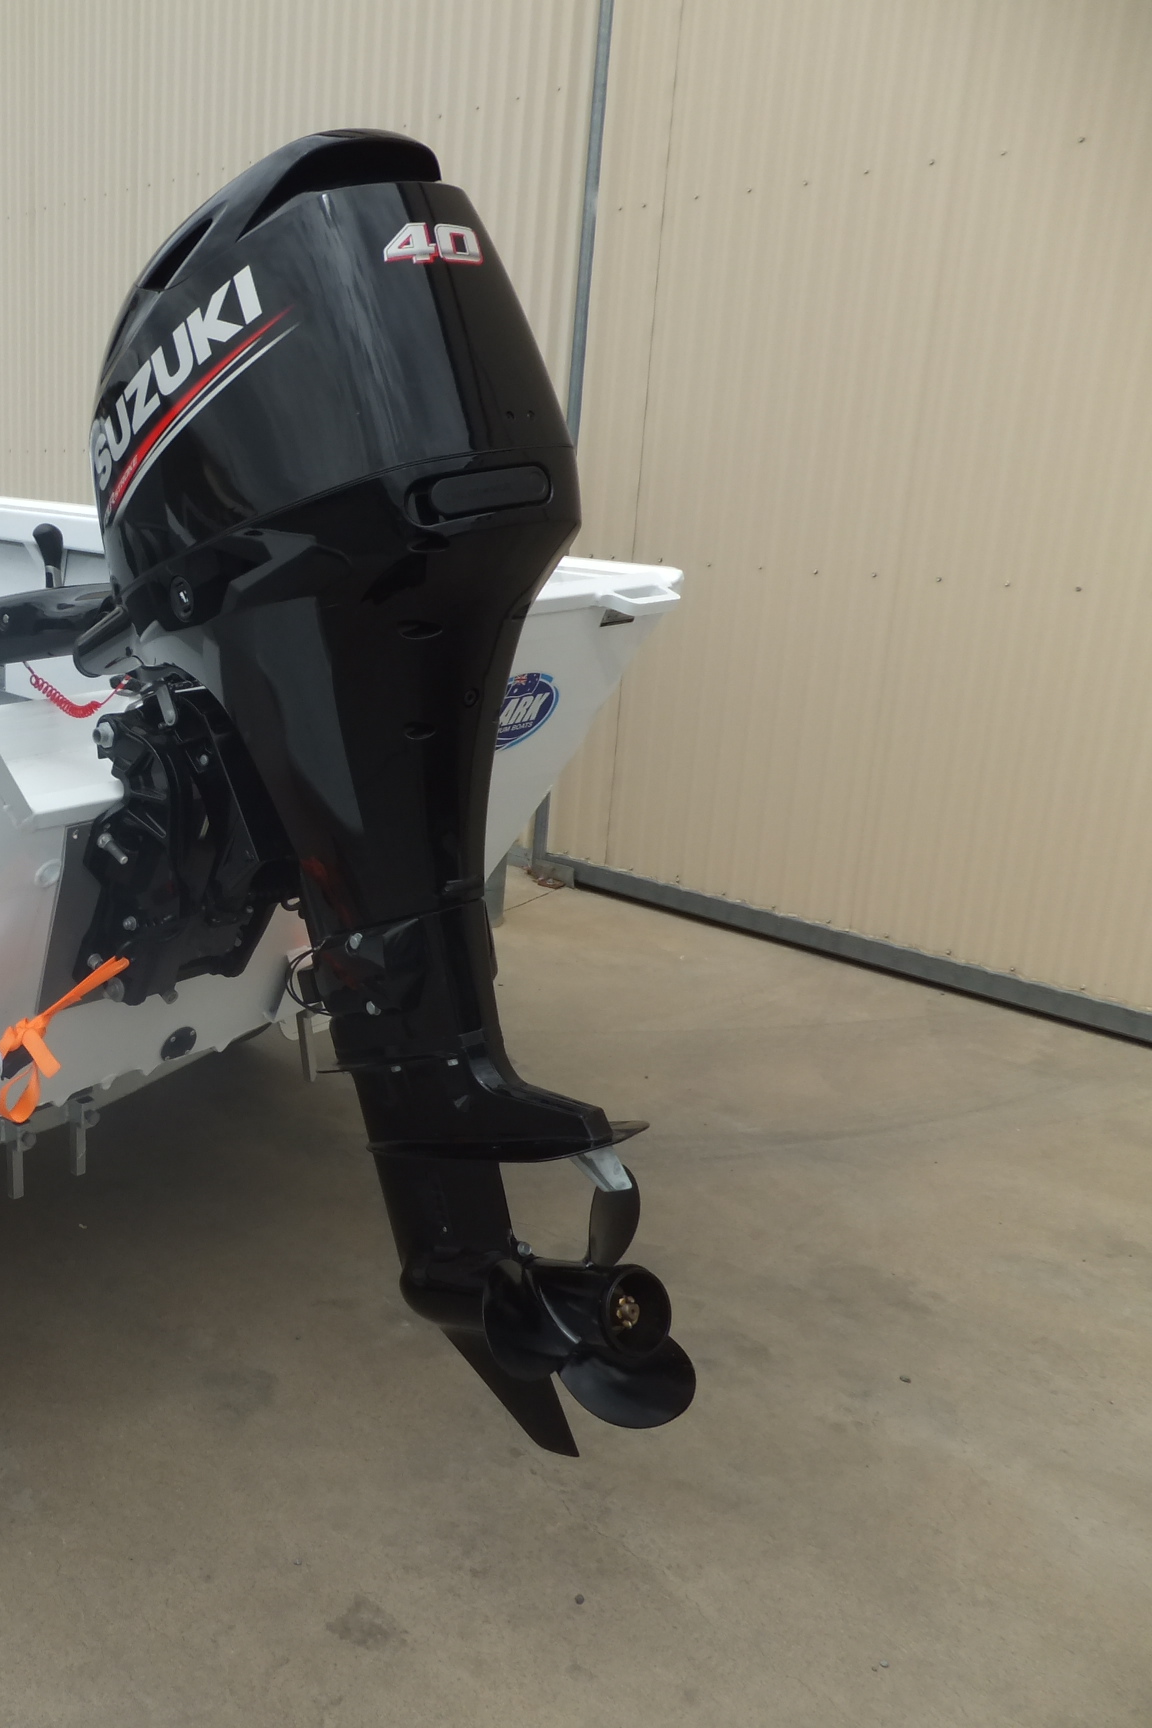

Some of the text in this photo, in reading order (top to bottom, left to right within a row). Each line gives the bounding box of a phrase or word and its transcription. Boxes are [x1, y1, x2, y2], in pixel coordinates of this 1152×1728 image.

[383, 222, 483, 266] 40
[93, 265, 263, 491] SUZUKI
[498, 692, 550, 727] ARK
